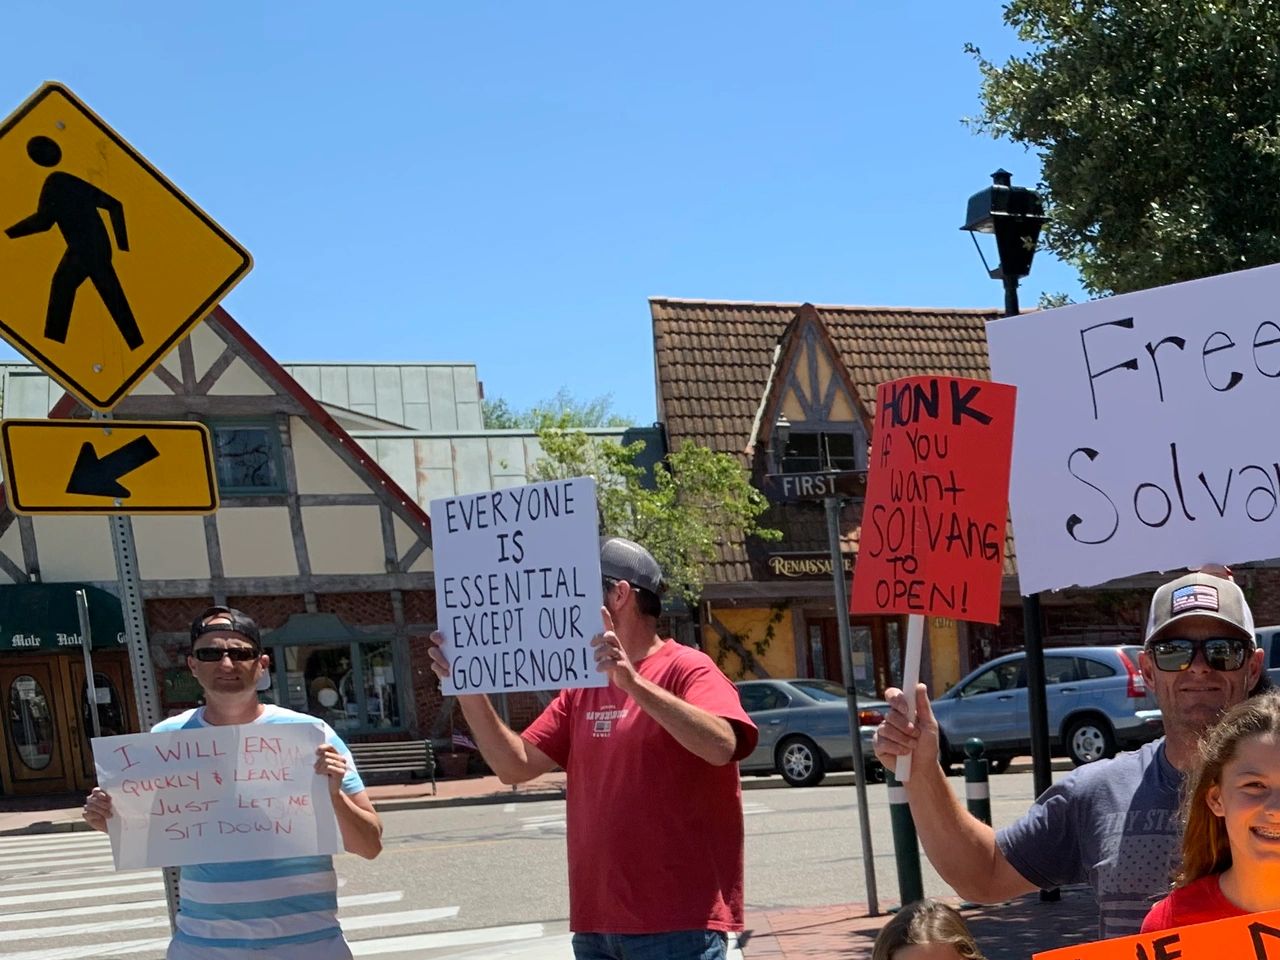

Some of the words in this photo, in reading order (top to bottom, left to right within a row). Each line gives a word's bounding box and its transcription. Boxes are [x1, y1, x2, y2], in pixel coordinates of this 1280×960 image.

[881, 379, 993, 430] HONK
[906, 428, 948, 464] YOU
[783, 475, 836, 497] FIRST
[858, 473, 868, 484] S
[891, 470, 965, 505] want
[446, 483, 575, 534] EVERYONE
[497, 530, 525, 564] IS
[768, 556, 853, 578] RENAISSAE
[886, 554, 919, 579] TO
[443, 566, 586, 609] ESSENTIAL
[875, 579, 968, 614] OPEN!
[452, 607, 524, 649] EXCEPT
[538, 604, 584, 640] OUR
[452, 647, 589, 691] GOVERNOR!
[114, 743, 140, 772] I
[155, 740, 227, 763] WILL
[244, 736, 284, 754] EAT
[233, 766, 296, 783] LEAVE
[151, 798, 219, 817] JUST
[237, 793, 274, 809] LET
[288, 794, 310, 807] ME
[164, 821, 209, 841] SIT
[218, 819, 293, 835] DOWN
